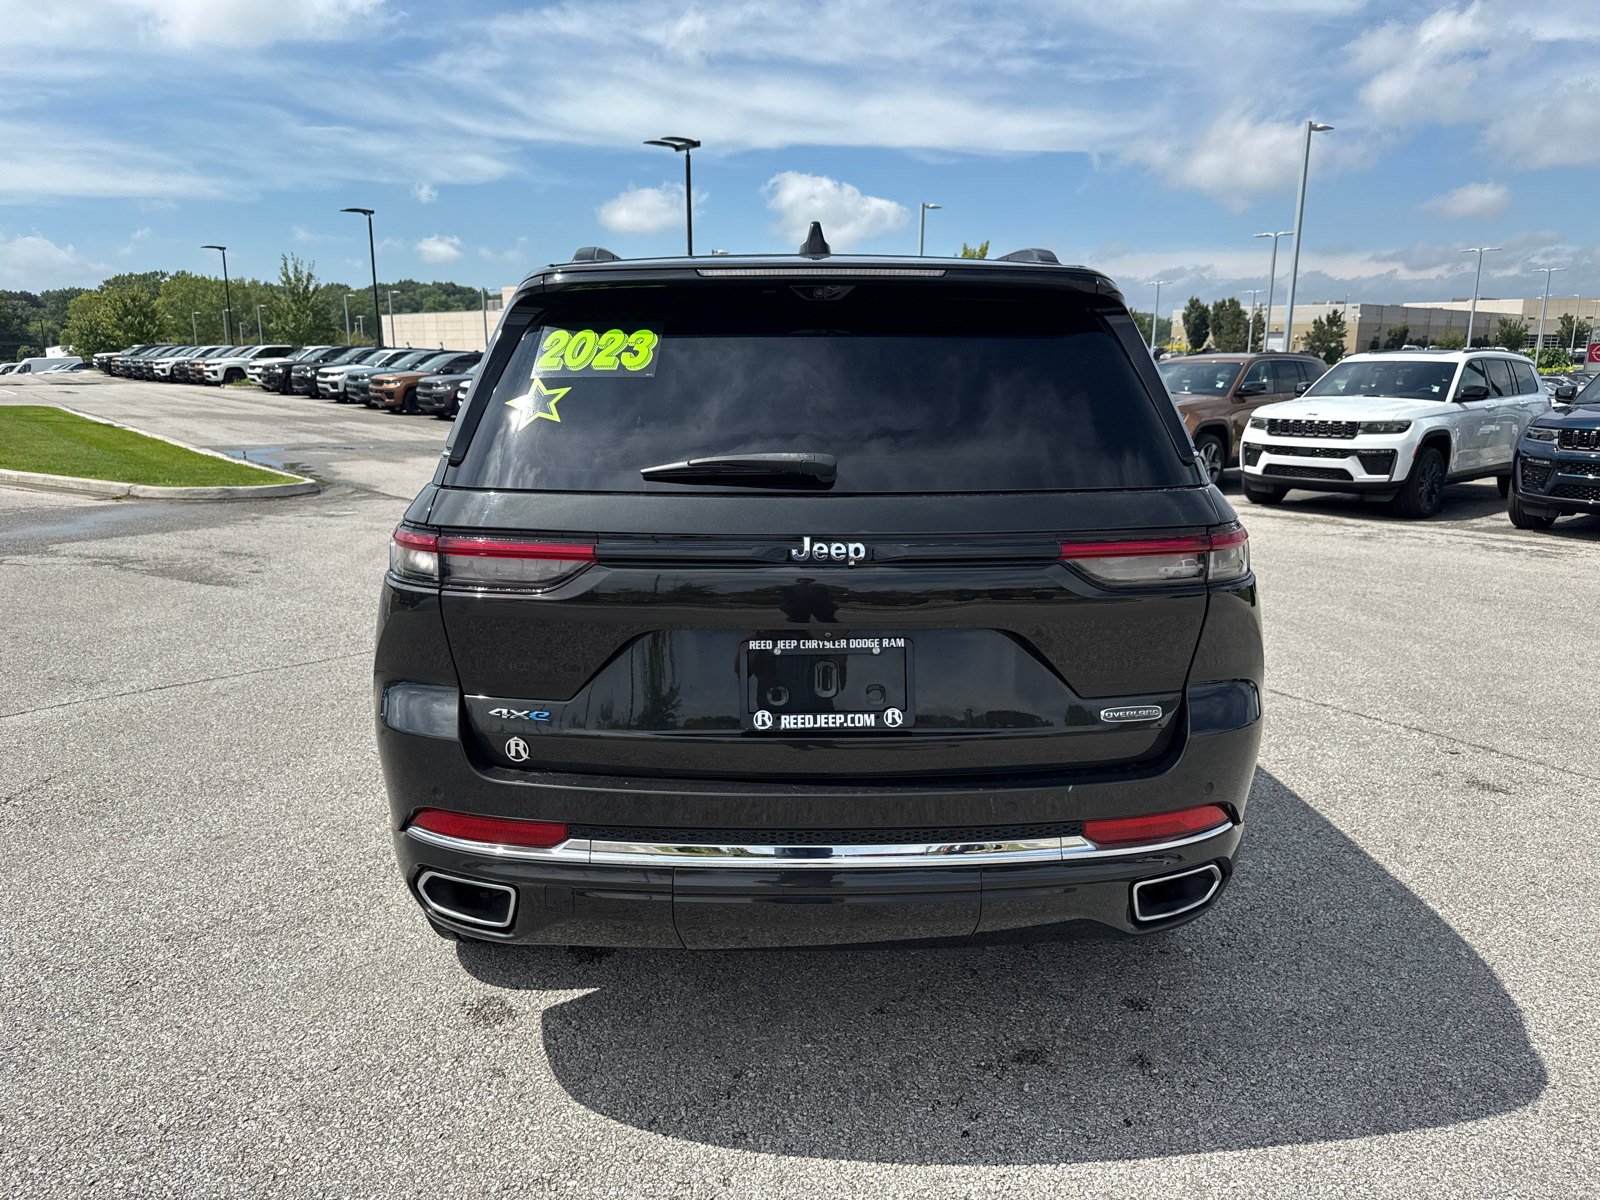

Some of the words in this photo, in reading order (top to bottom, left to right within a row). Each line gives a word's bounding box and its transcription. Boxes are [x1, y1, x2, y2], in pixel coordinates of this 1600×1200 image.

[535, 329, 658, 371] 2023
[791, 536, 866, 566] Jeep
[749, 640, 773, 650] REED
[777, 639, 798, 650] JEEP
[800, 639, 847, 649] CHRYSLER
[849, 638, 880, 649] DODGE
[882, 638, 905, 648] RAM
[755, 710, 773, 729] R
[780, 713, 875, 729] REEDJEEP.COM
[885, 708, 903, 727] R
[1104, 709, 1160, 719] OVERLAND
[507, 738, 530, 760] R
